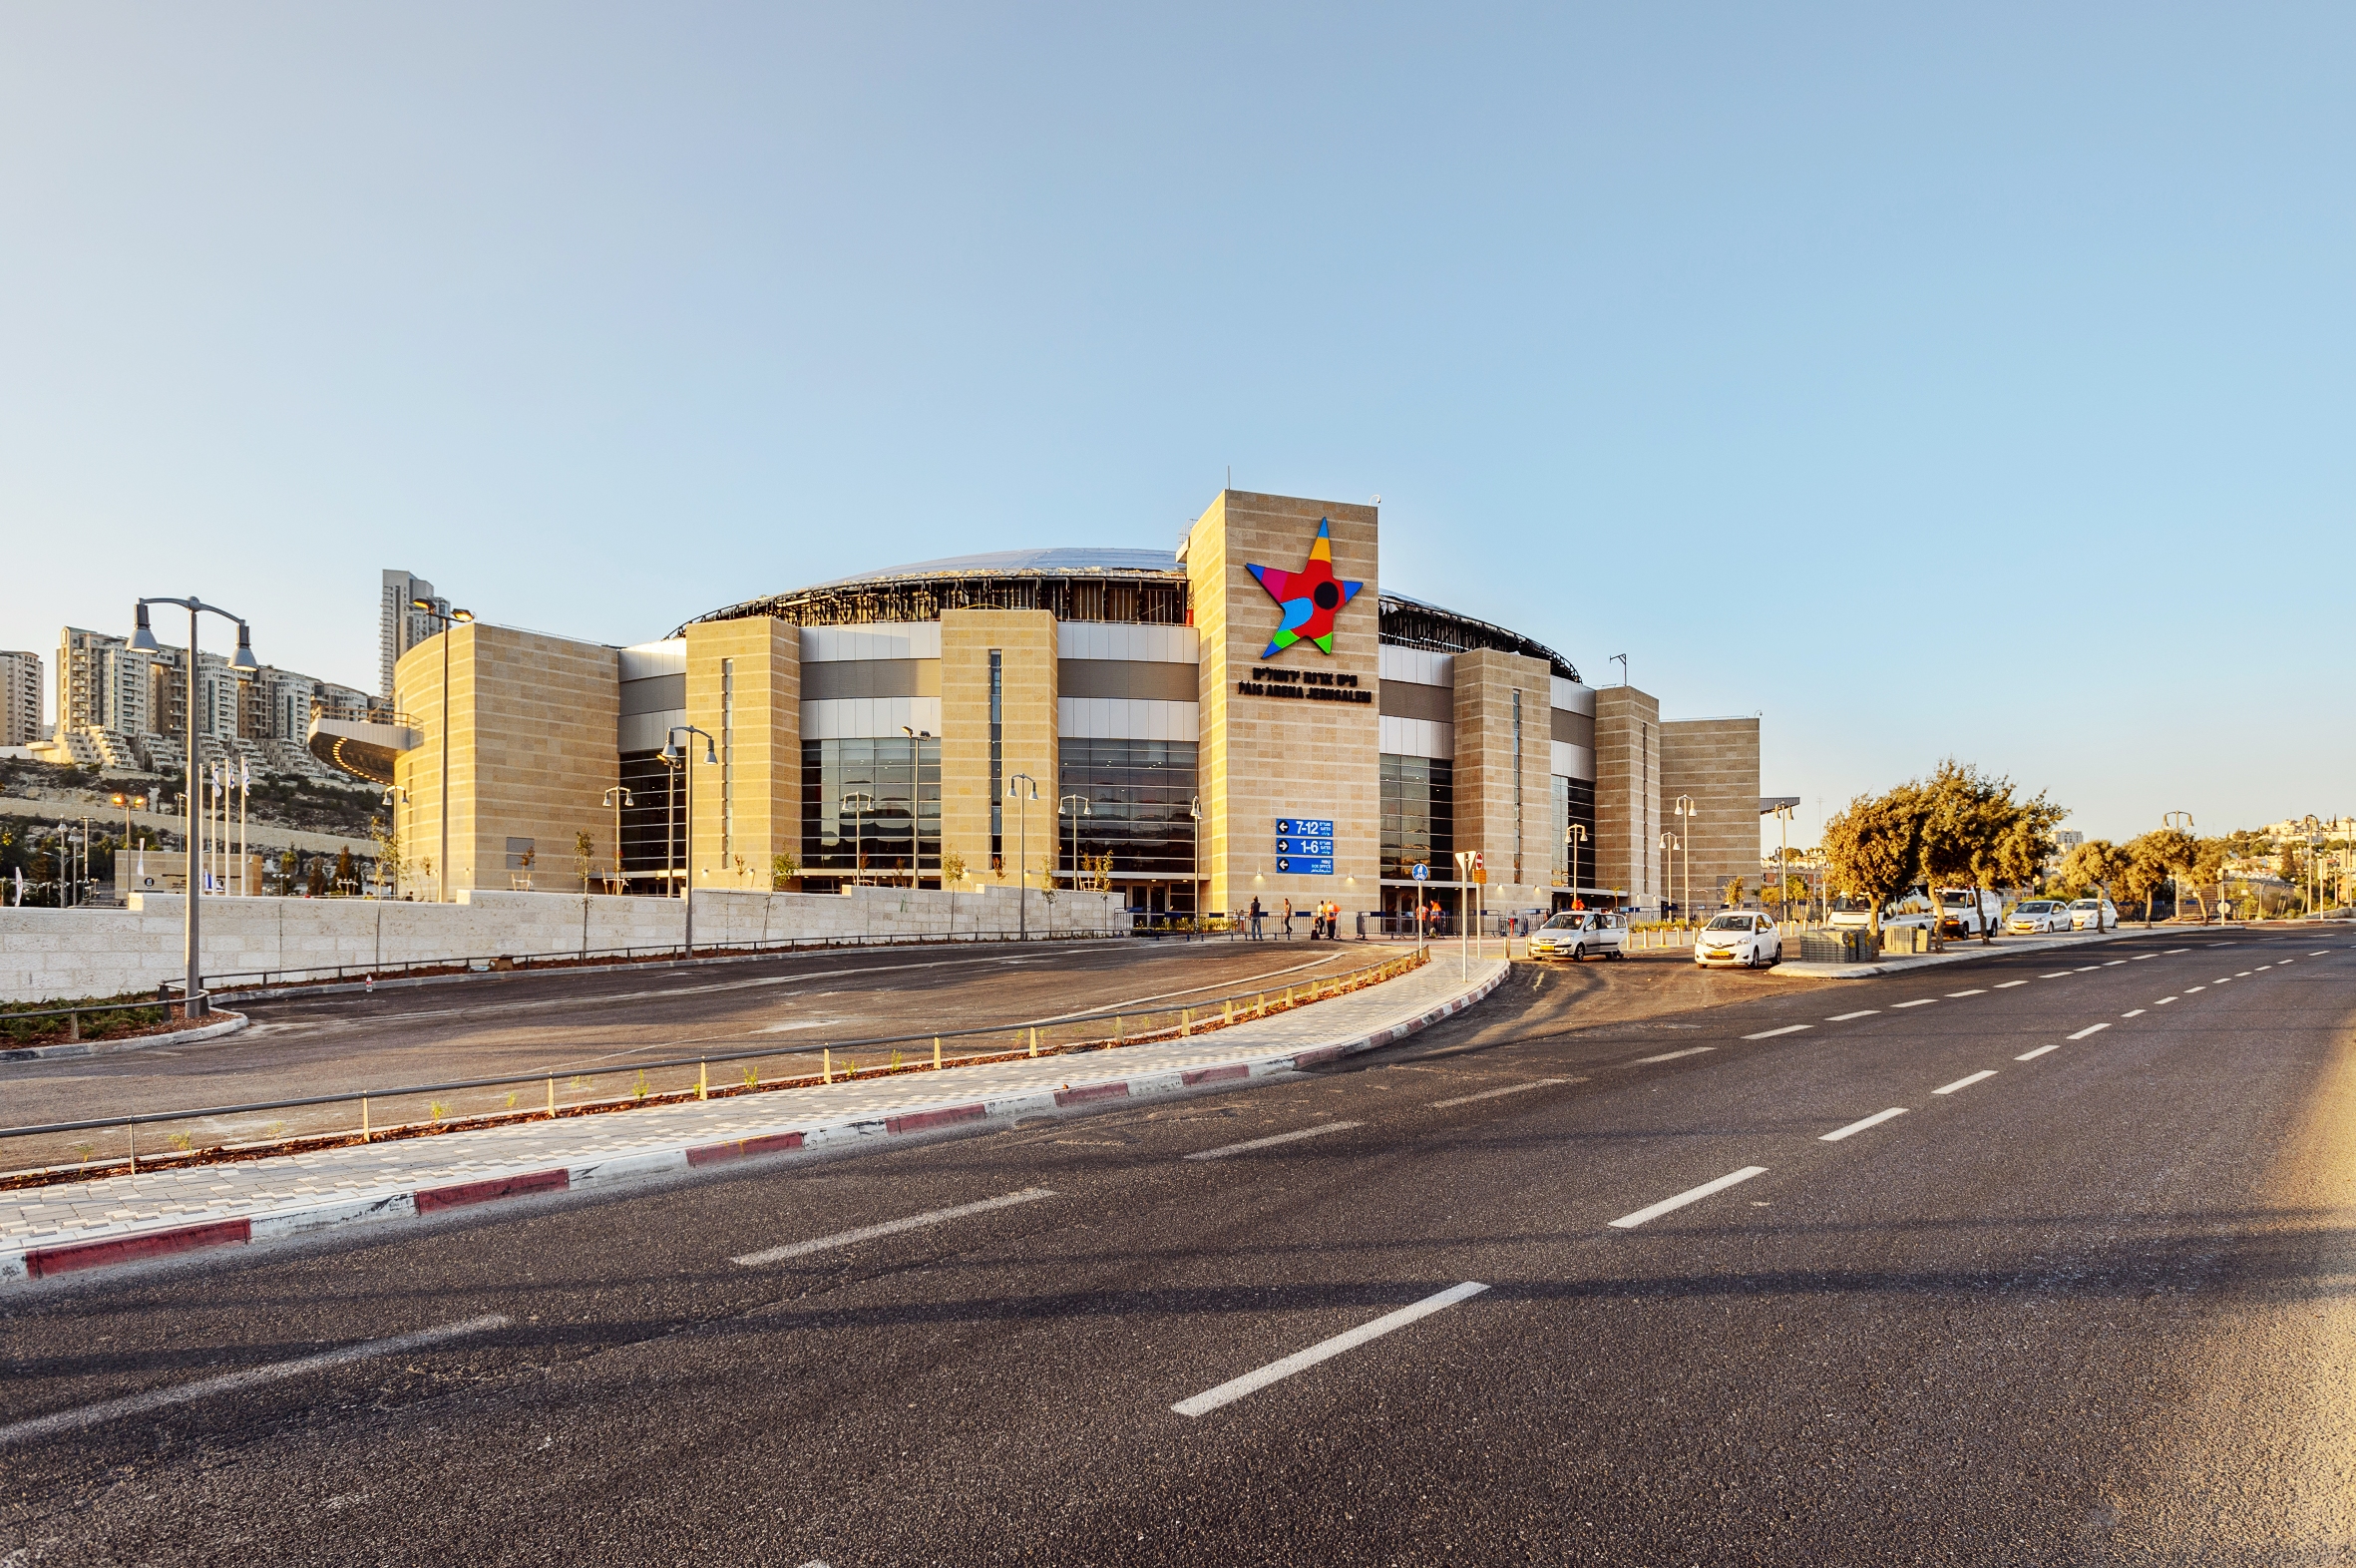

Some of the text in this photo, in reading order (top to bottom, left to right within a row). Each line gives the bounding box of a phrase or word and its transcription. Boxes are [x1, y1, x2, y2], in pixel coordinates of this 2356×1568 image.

[1238, 681, 1372, 703] PAIS ARENA JERUSALEM
[1296, 821, 1319, 835] 7-12
[1300, 840, 1319, 854] 1-6
